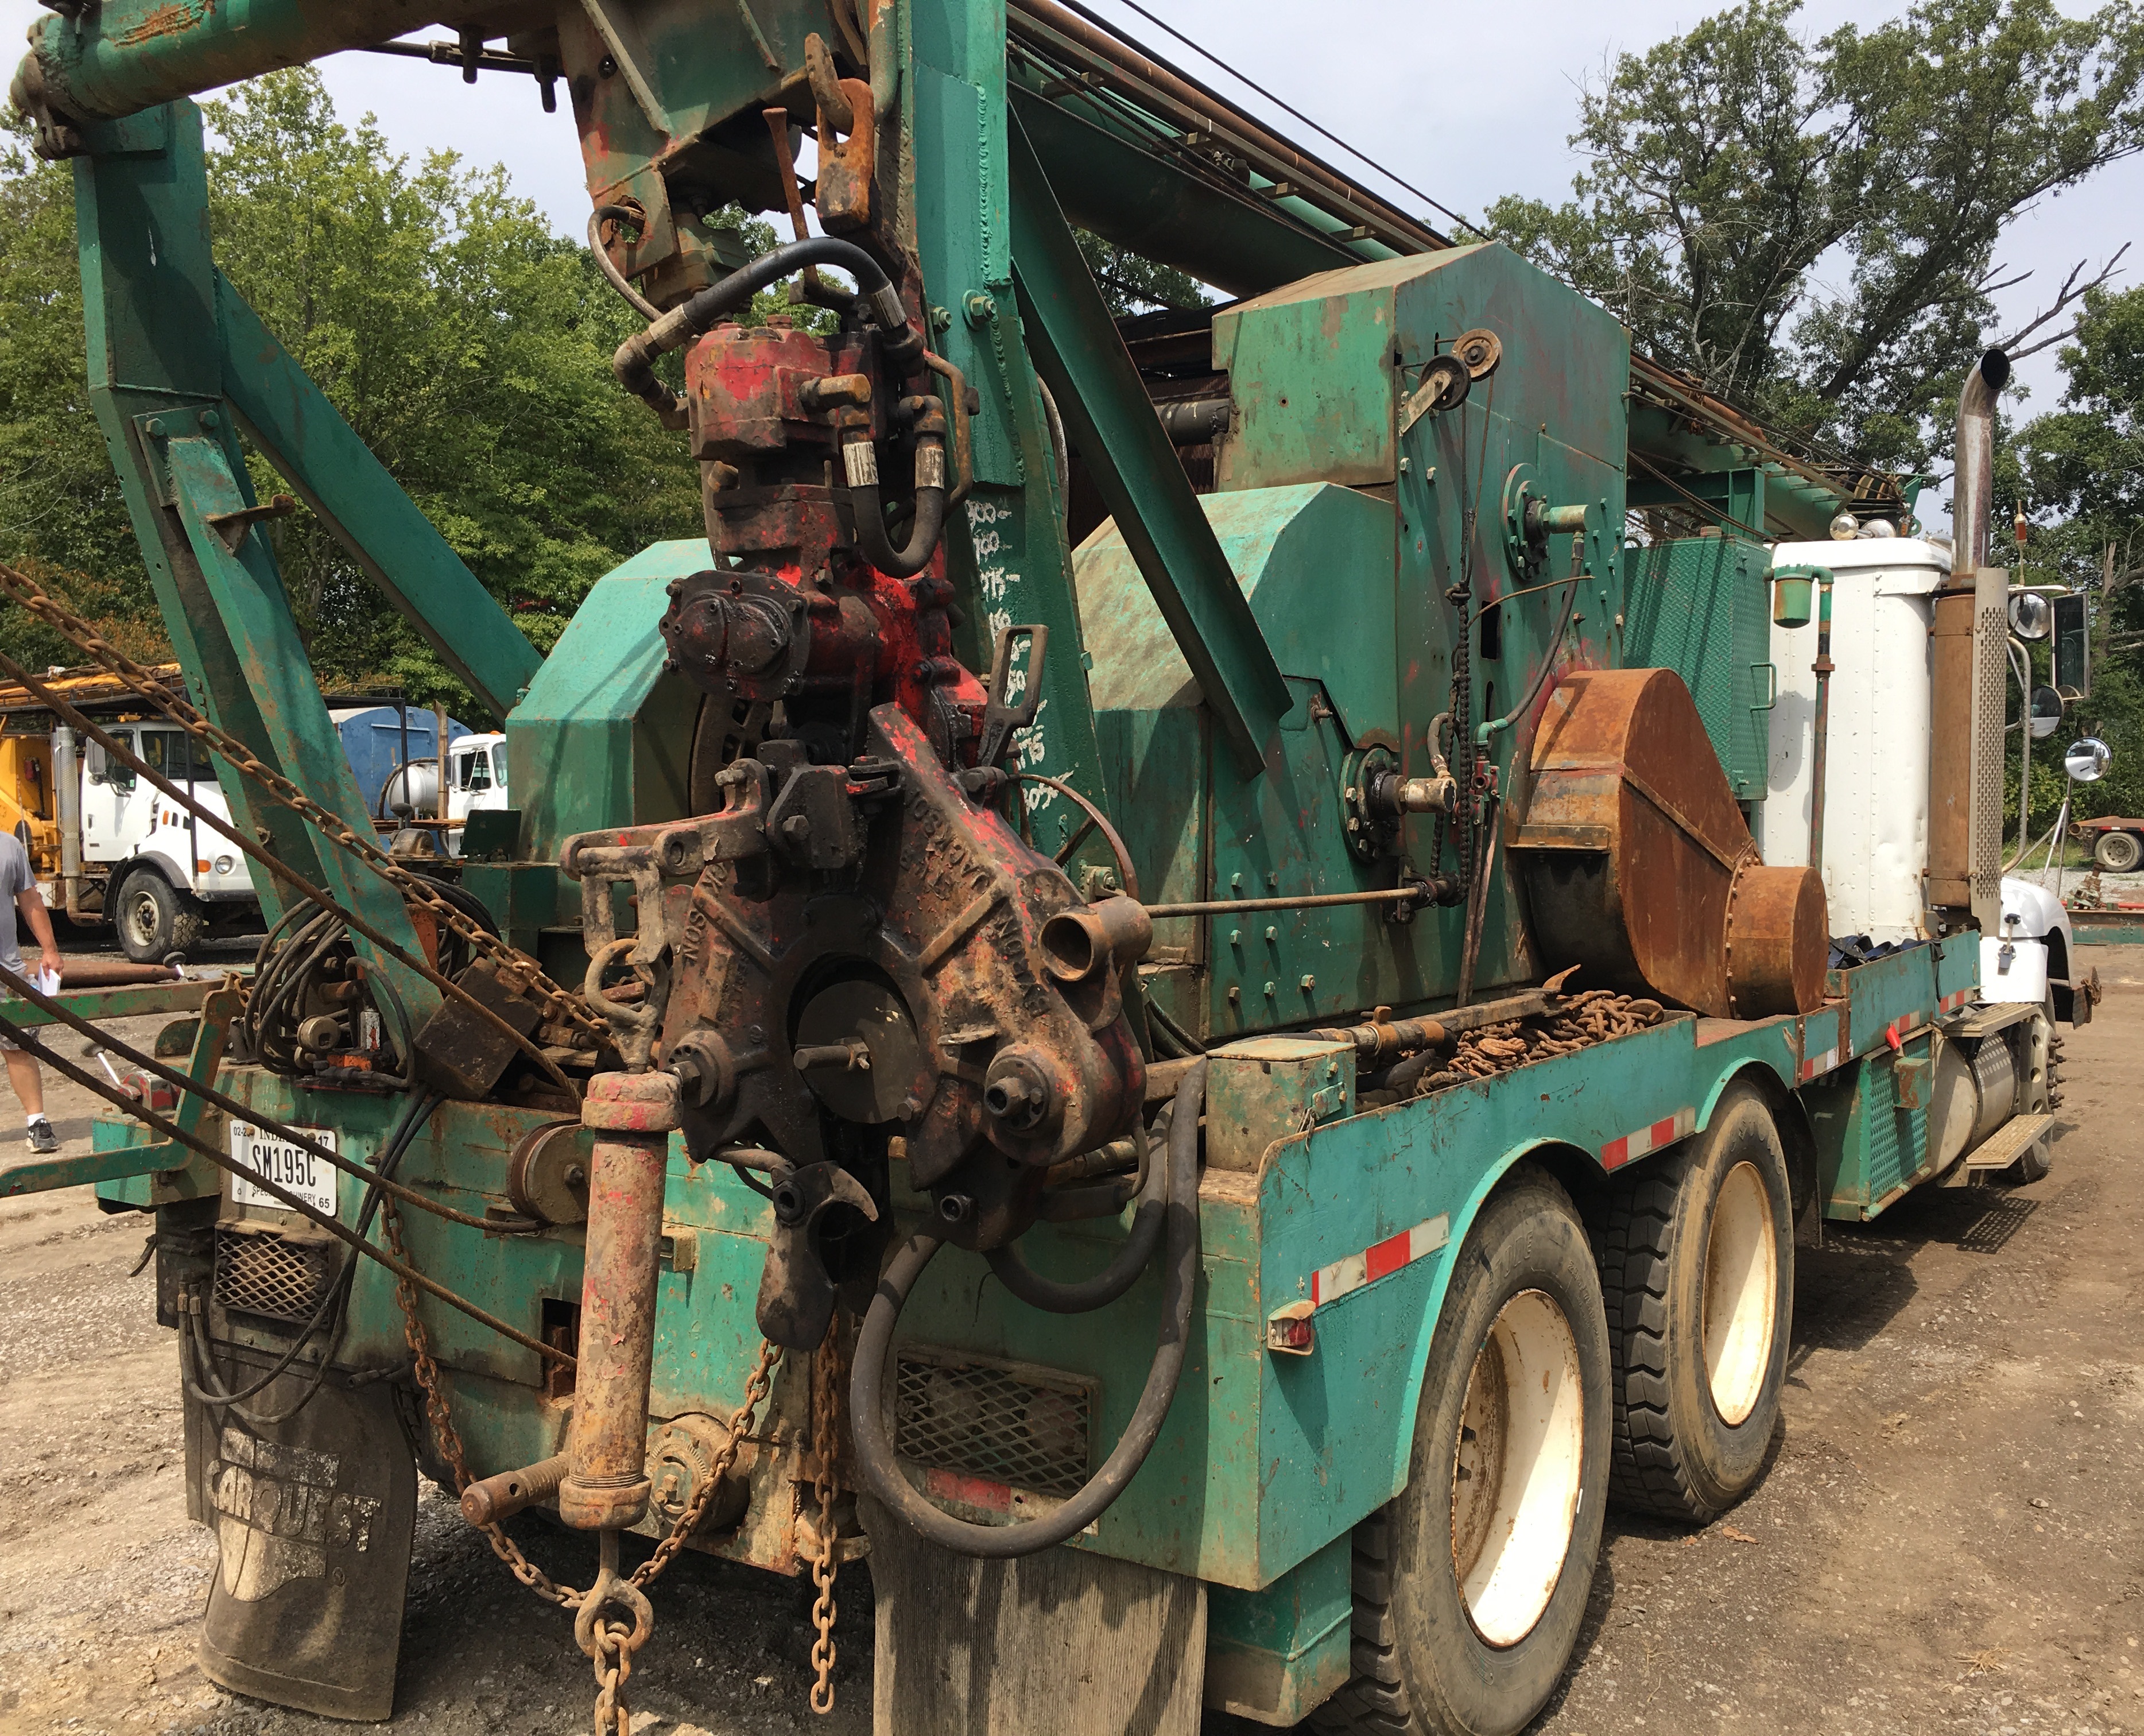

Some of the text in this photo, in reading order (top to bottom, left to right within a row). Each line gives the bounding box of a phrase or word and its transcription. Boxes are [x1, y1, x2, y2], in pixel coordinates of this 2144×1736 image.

[253, 1144, 316, 1187] SM195C
[319, 1198, 330, 1208] 65
[206, 1459, 382, 1553] CARQUEST
